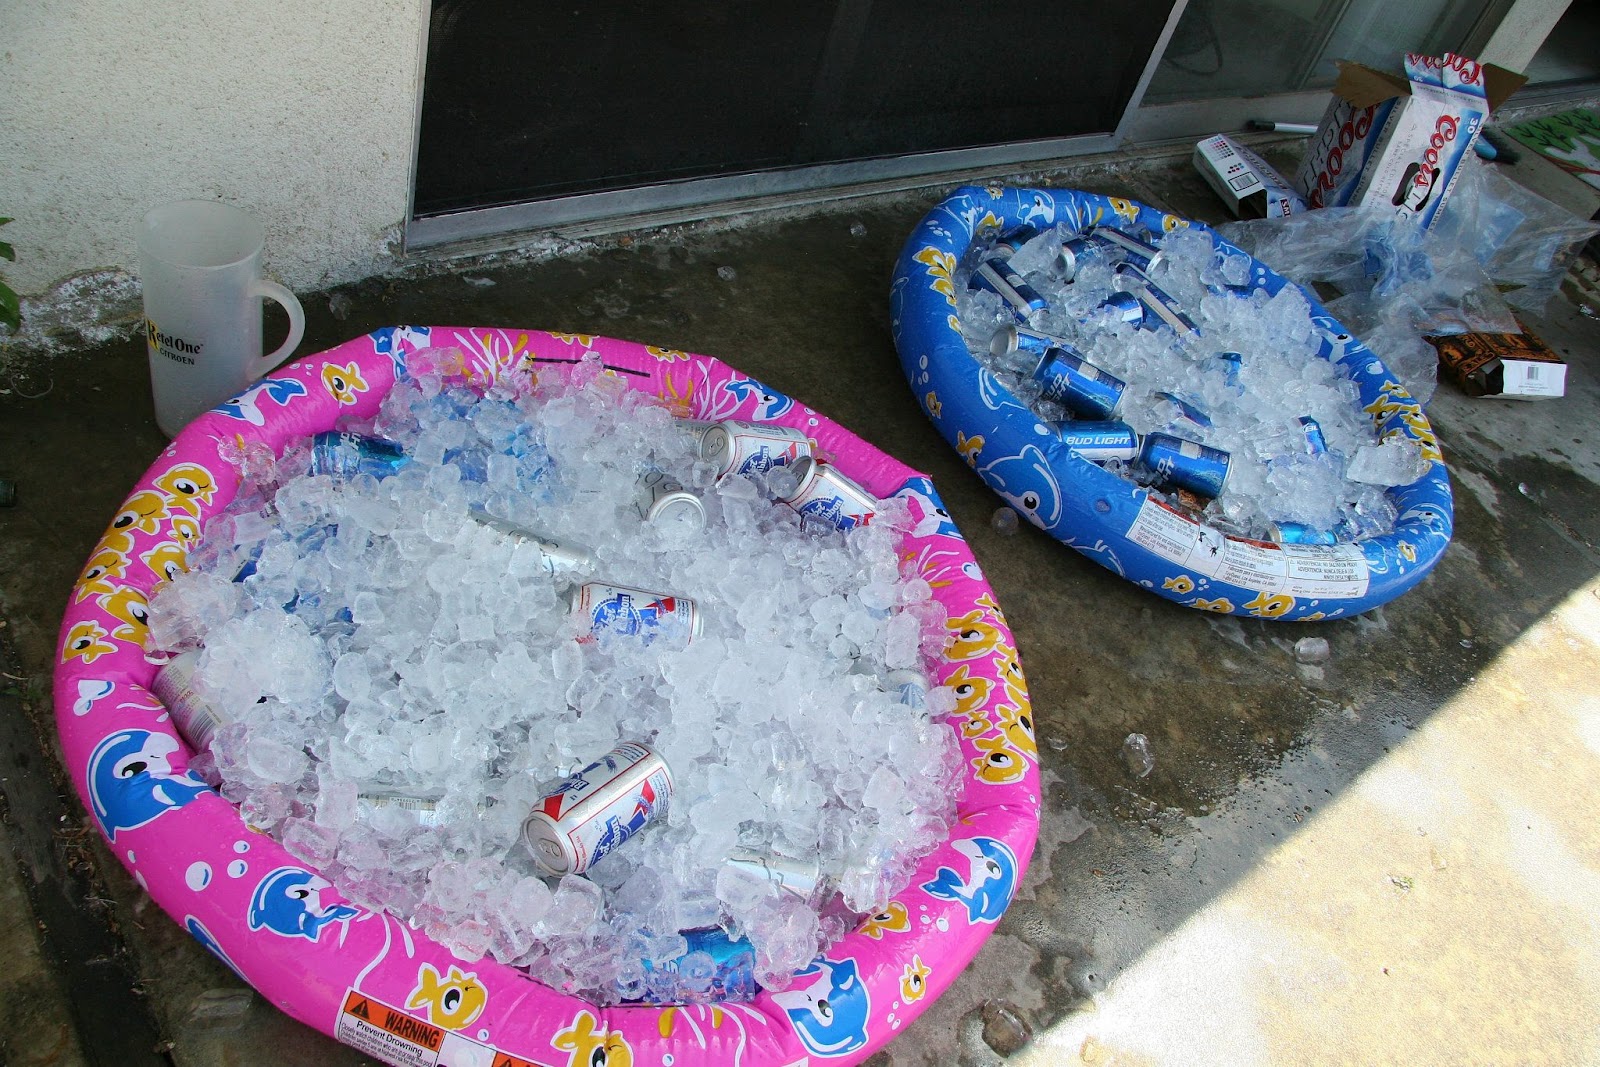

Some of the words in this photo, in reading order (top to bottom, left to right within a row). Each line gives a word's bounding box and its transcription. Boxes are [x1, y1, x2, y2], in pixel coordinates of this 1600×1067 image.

[1467, 118, 1479, 134] 30
[1413, 114, 1460, 188] Coors
[175, 338, 200, 354] One
[160, 348, 194, 365] CITROEN
[1066, 436, 1092, 444] BUD
[1094, 436, 1131, 444] LIGHT
[384, 1011, 439, 1048] WARNING
[357, 1021, 385, 1039] Prevent
[386, 1034, 422, 1056] Drowning
